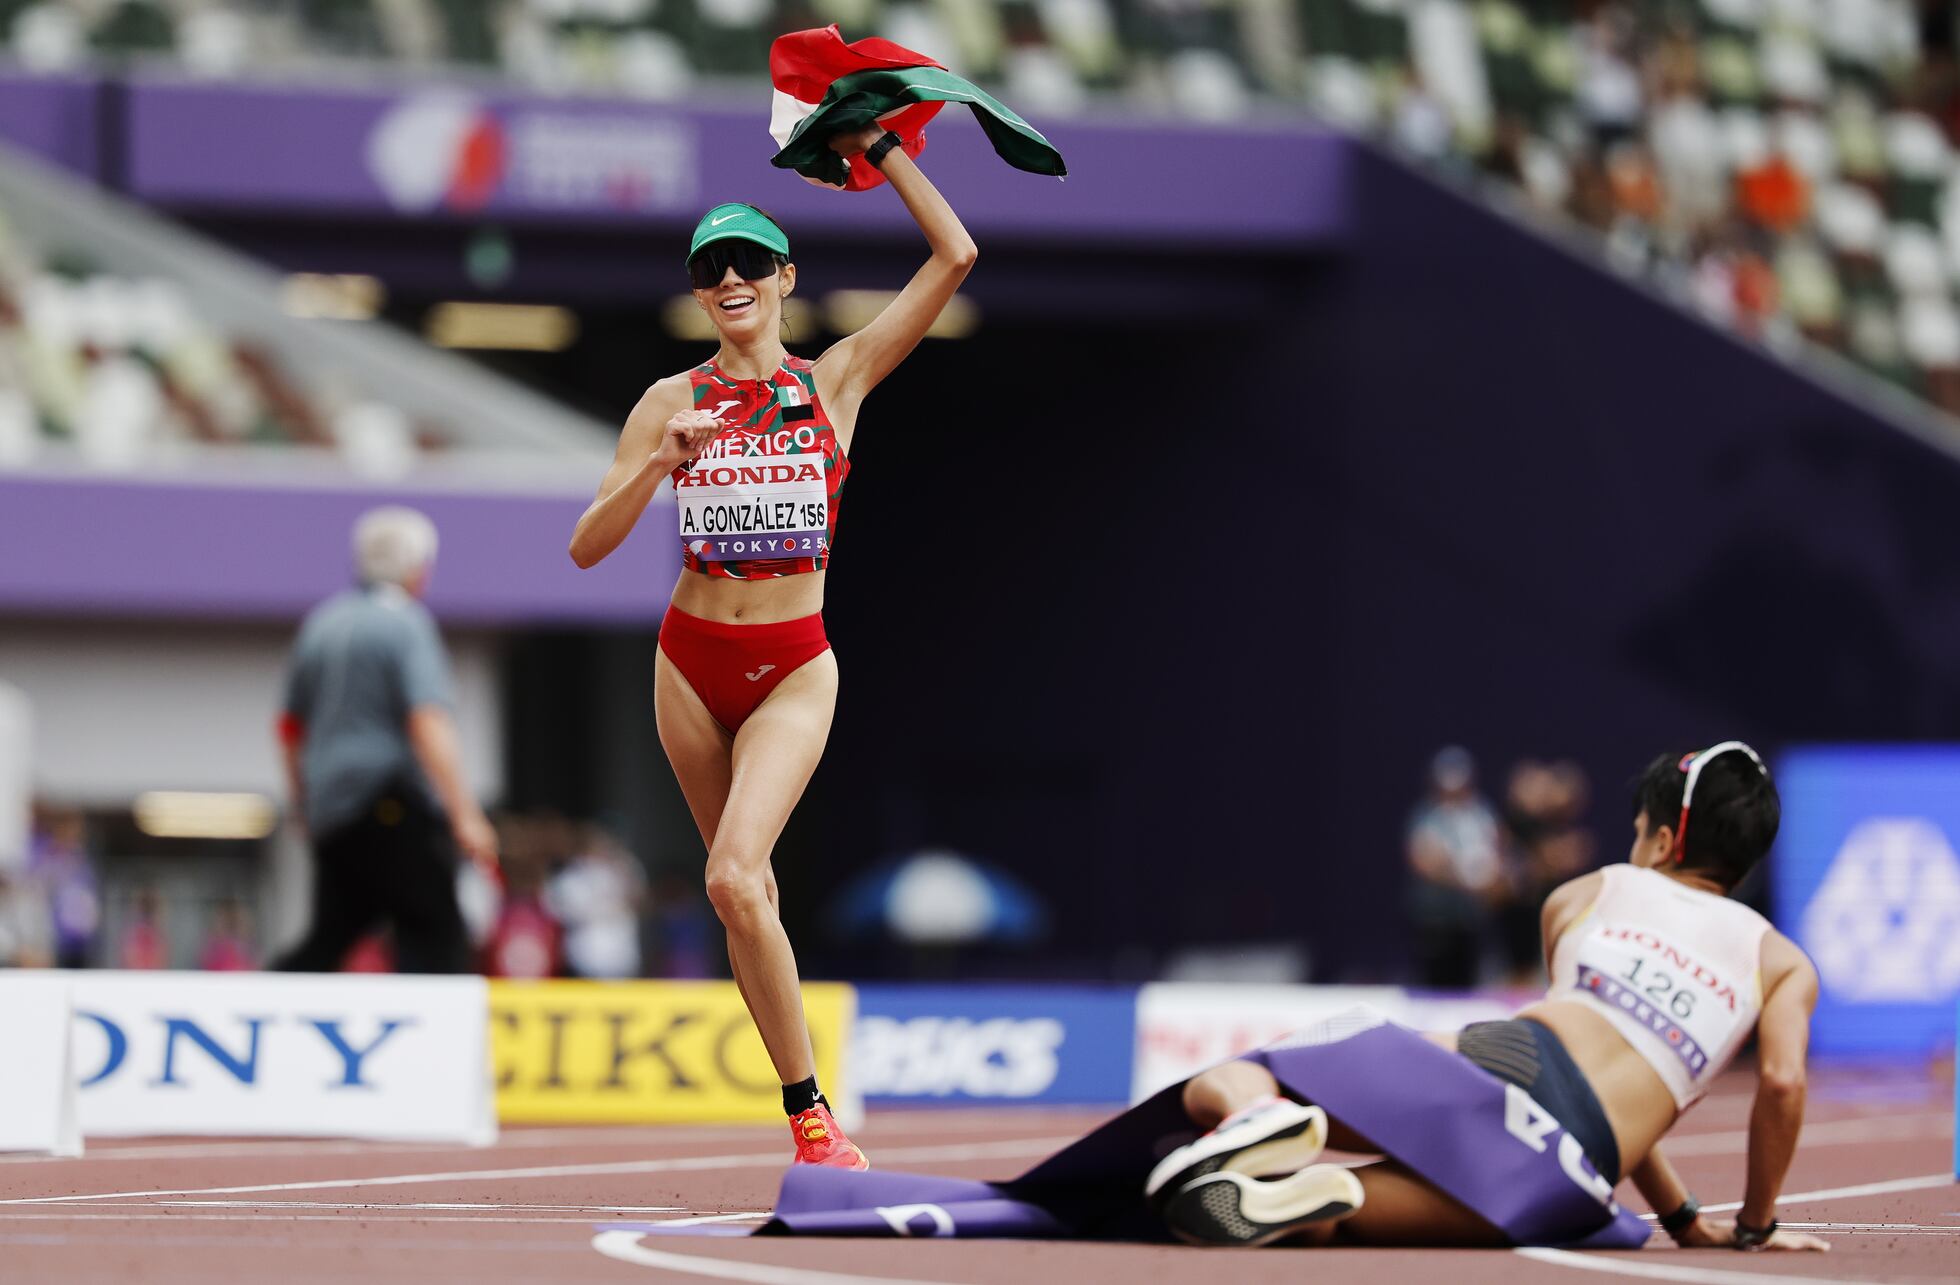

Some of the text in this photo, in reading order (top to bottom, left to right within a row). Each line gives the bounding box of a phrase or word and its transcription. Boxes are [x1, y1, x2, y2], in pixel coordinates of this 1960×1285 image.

[701, 426, 815, 459] MÉXICO
[680, 463, 823, 487] HONDA
[683, 497, 825, 533] A. GONZÁLEZ 156
[1601, 926, 1737, 1014] HONDA
[1621, 957, 1696, 1020] 126
